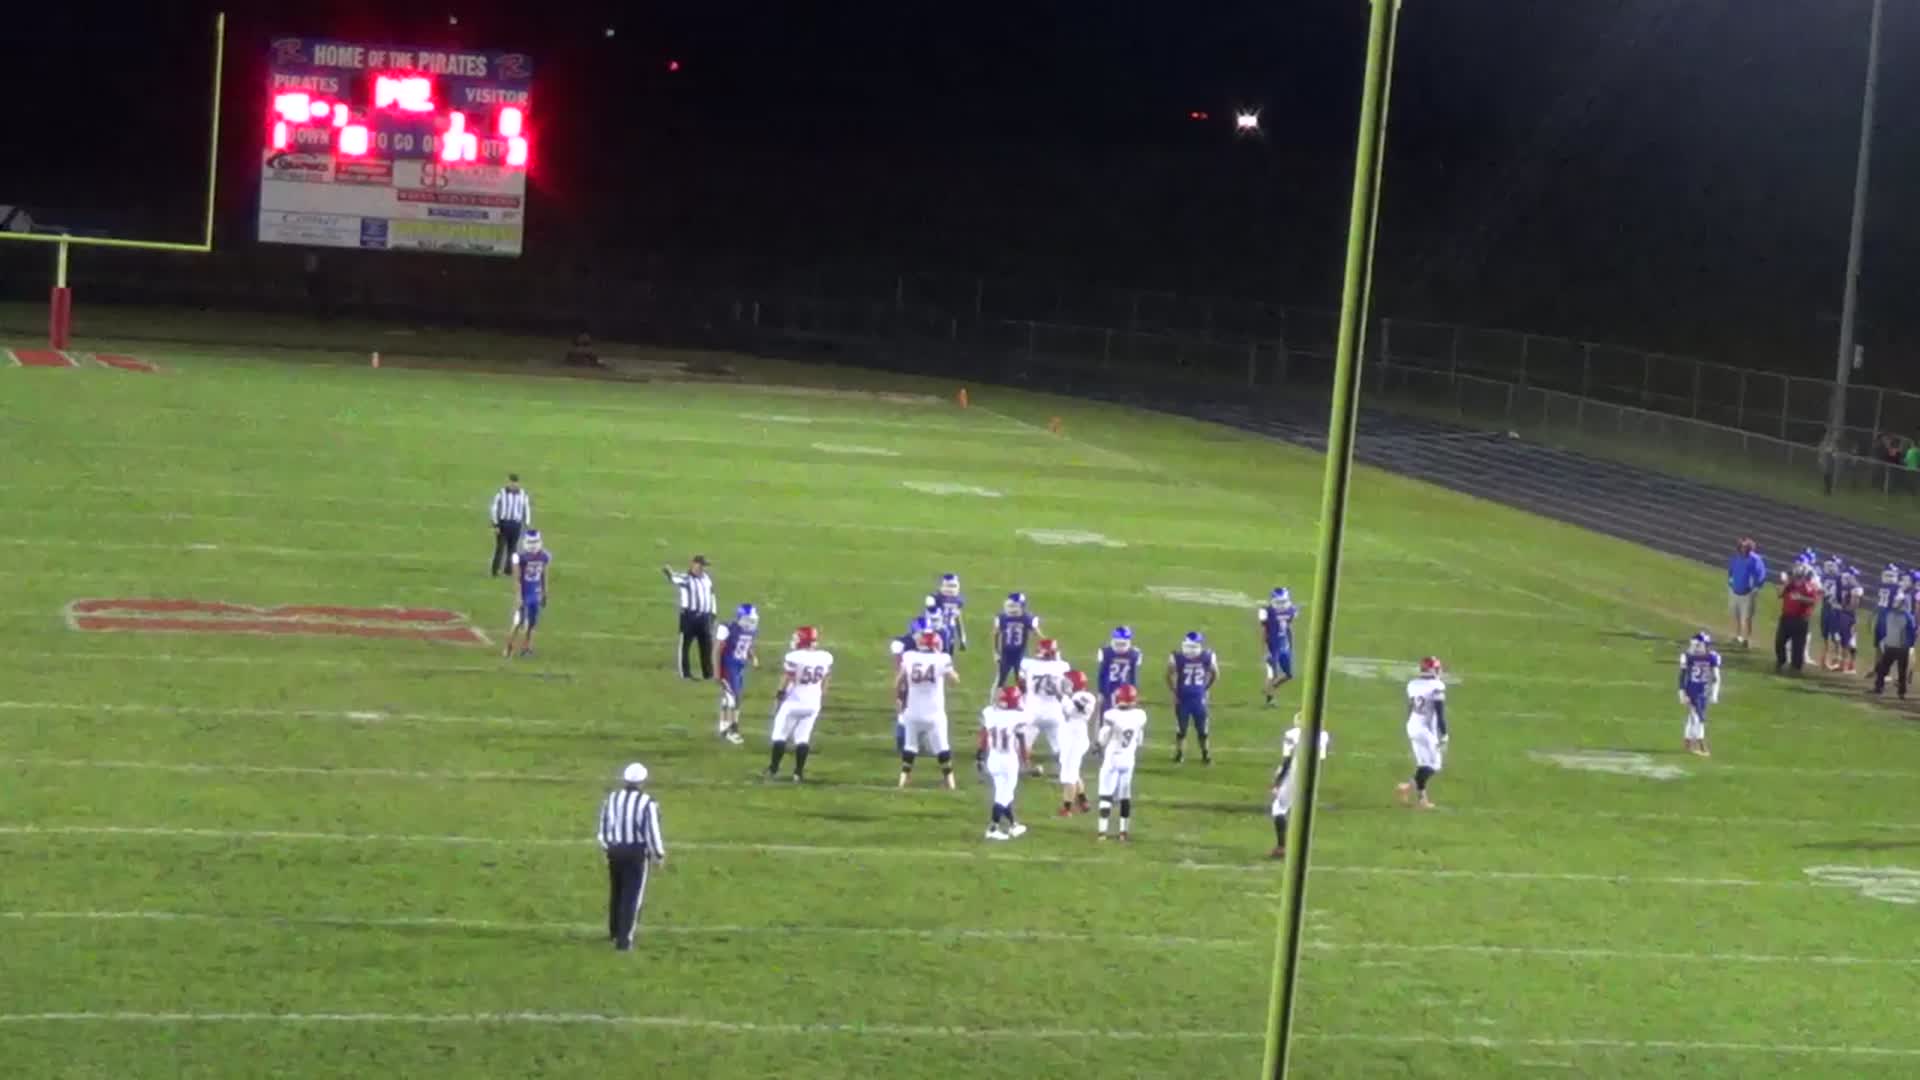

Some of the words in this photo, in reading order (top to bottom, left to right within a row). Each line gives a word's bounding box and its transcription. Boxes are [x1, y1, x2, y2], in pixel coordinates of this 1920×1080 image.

[314, 44, 365, 69] HOME
[367, 50, 387, 69] OF
[389, 51, 414, 71] THE
[418, 51, 489, 77] PIRATES
[273, 74, 339, 93] PIRATES
[464, 87, 529, 107] VISITOR
[393, 133, 414, 152] GO
[1183, 667, 1205, 686] 72
